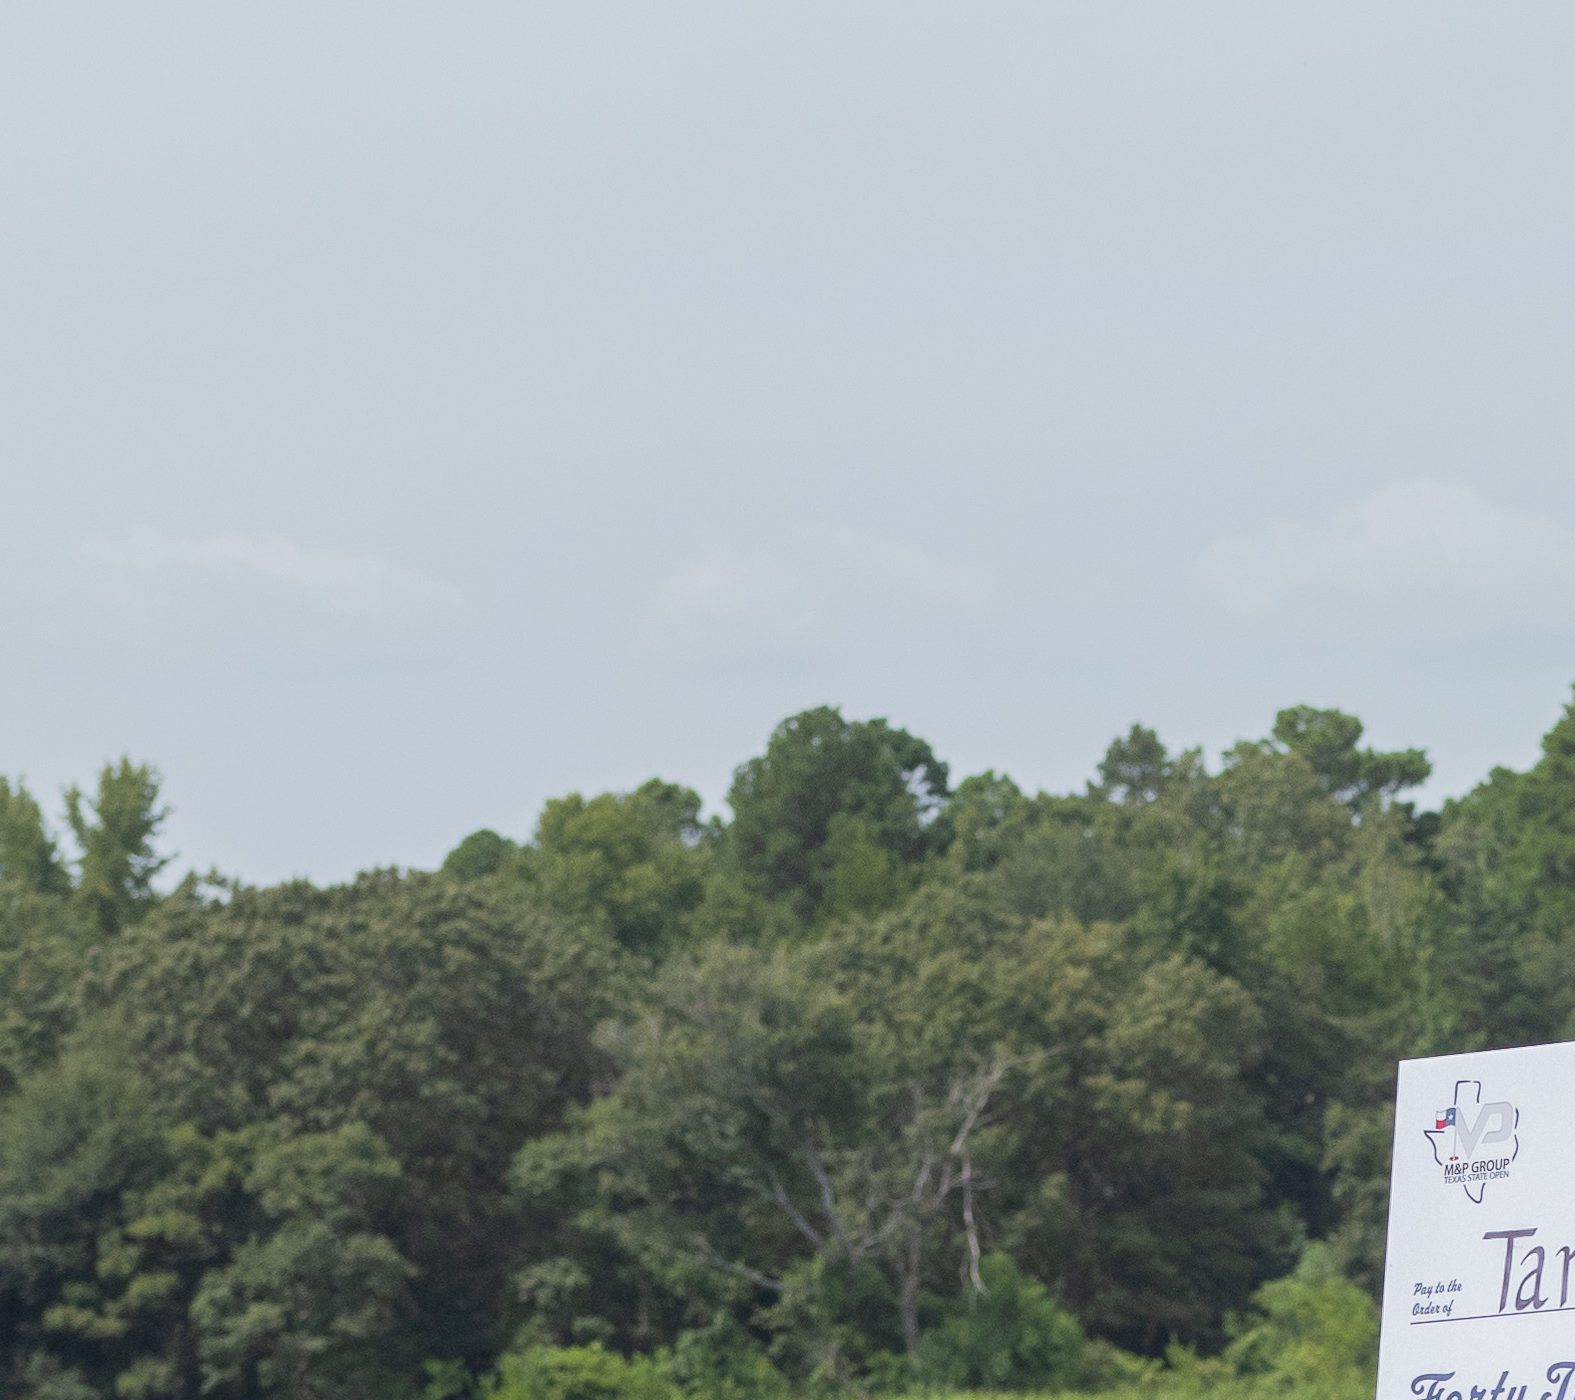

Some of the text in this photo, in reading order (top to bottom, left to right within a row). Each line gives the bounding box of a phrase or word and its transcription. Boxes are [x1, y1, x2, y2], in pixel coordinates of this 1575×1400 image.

[1444, 1158, 1510, 1176] M&P GROUP
[1444, 1170, 1510, 1184] TEXAS STATE OPEN
[1413, 1278, 1462, 1298] Pay to the
[1412, 1299, 1455, 1317] Order of
